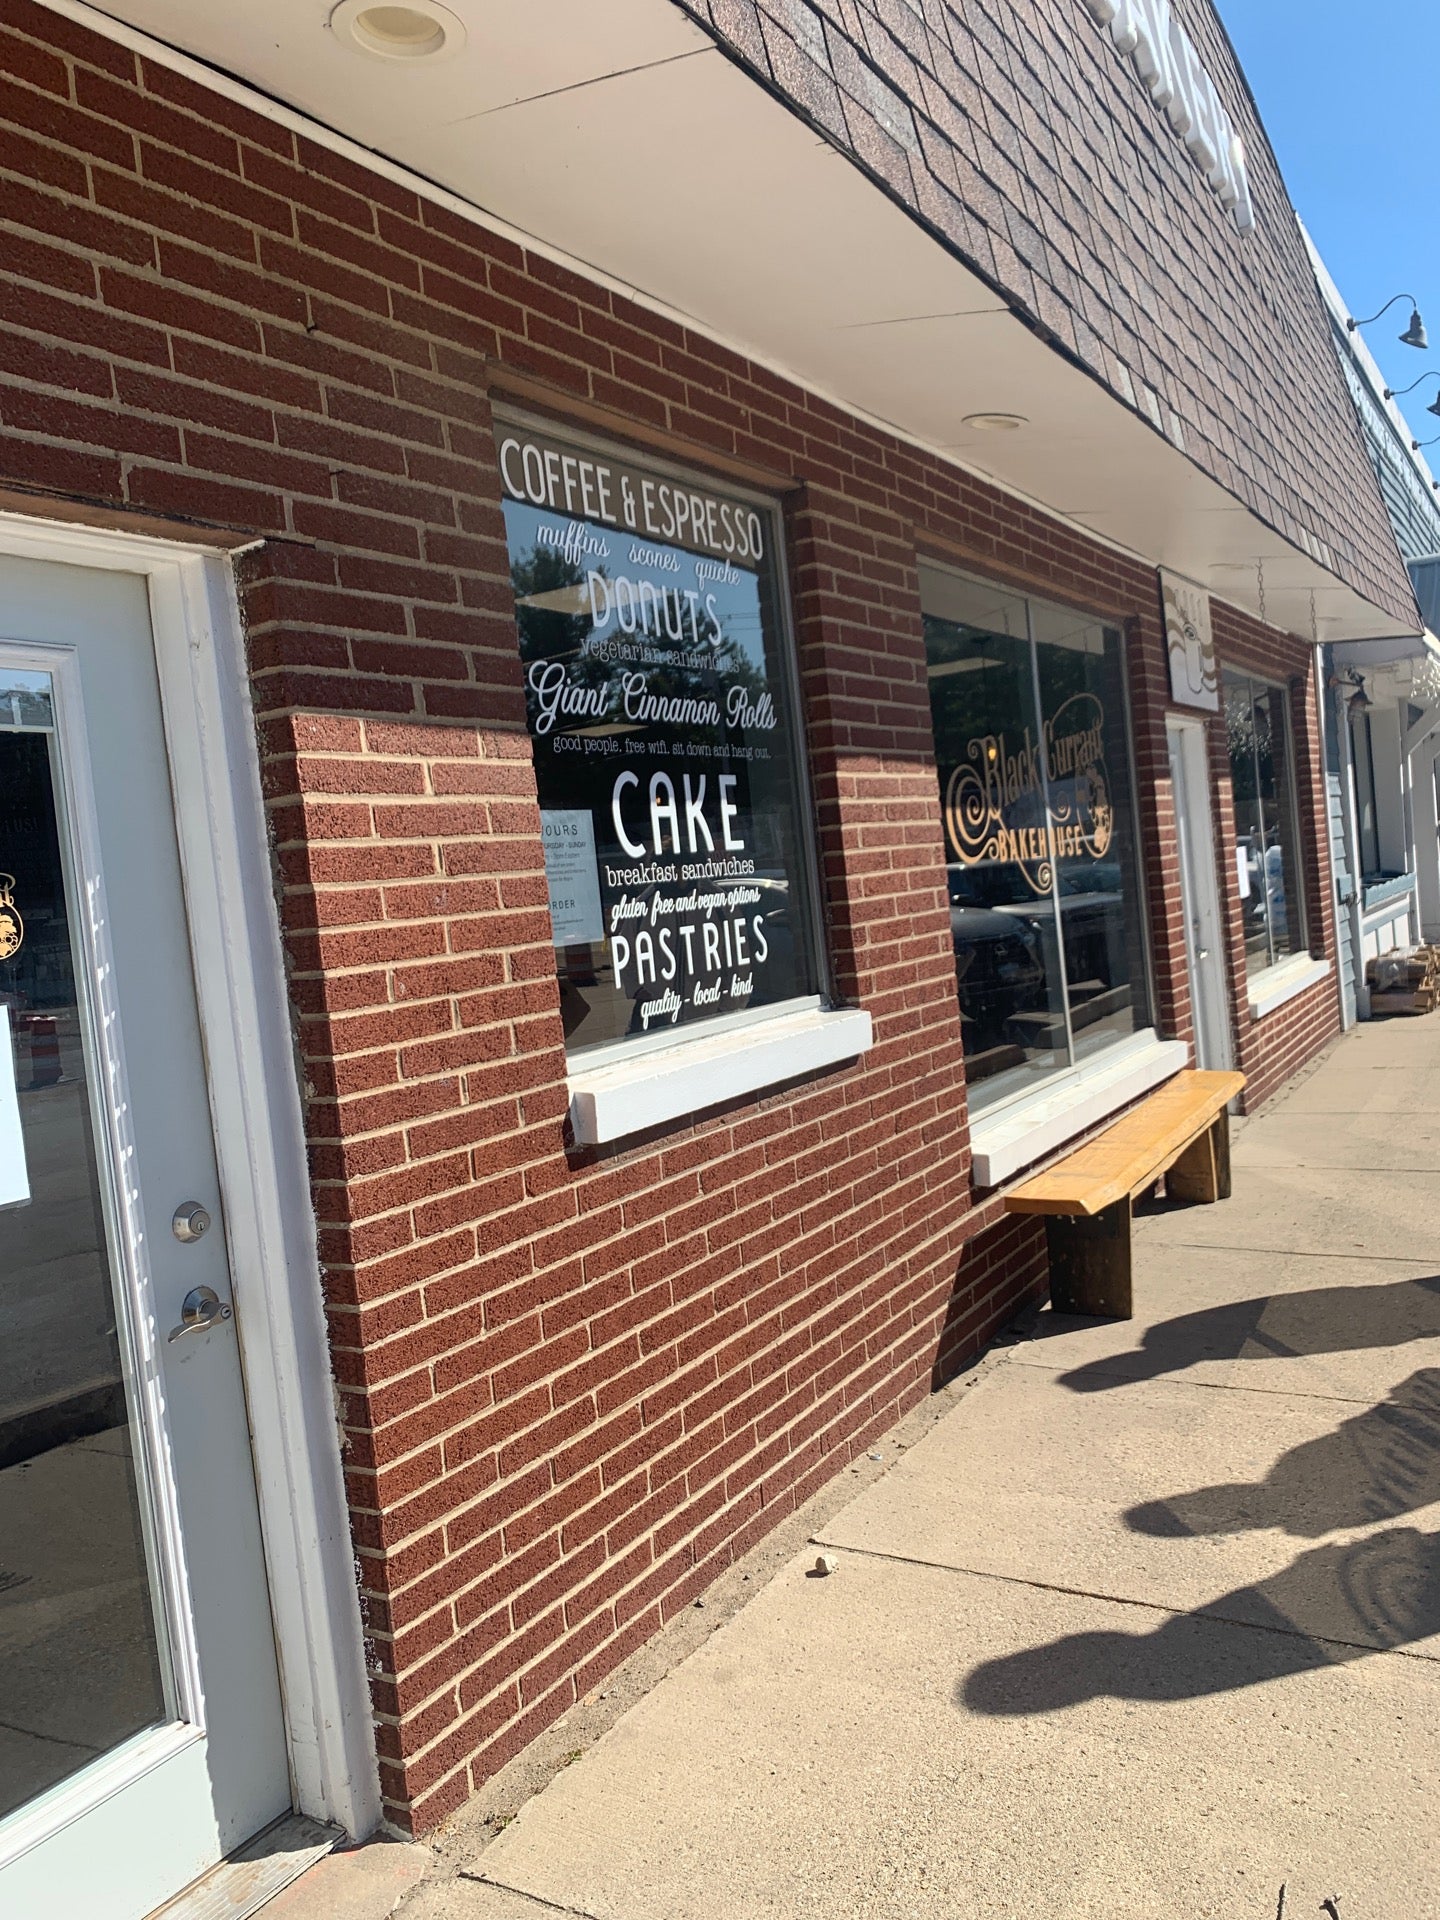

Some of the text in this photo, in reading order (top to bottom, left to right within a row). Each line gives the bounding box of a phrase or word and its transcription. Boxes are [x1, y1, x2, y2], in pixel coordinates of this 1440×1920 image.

[500, 438, 764, 561] COFFEE & ESPRESSO
[536, 521, 741, 590] muffins scones quiche
[587, 569, 723, 647] DONUTS
[580, 637, 662, 664] vegetarian
[528, 660, 778, 735] Giant Cinnamon Rolls
[553, 735, 582, 753] good
[584, 737, 622, 755] people.
[624, 738, 646, 754] free
[672, 741, 685, 756] sit
[686, 742, 713, 757] down
[712, 743, 731, 758] and
[731, 744, 754, 761] hang
[967, 727, 1041, 819] Black
[541, 824, 578, 836] OURS
[612, 770, 745, 858] CAKE
[605, 856, 755, 888] breakfast sandwiches
[611, 886, 761, 932] gluten free and vegan options
[611, 914, 769, 989] PASTRIES
[640, 987, 682, 1030] quality
[693, 976, 721, 1006] local
[730, 972, 754, 997] kind
